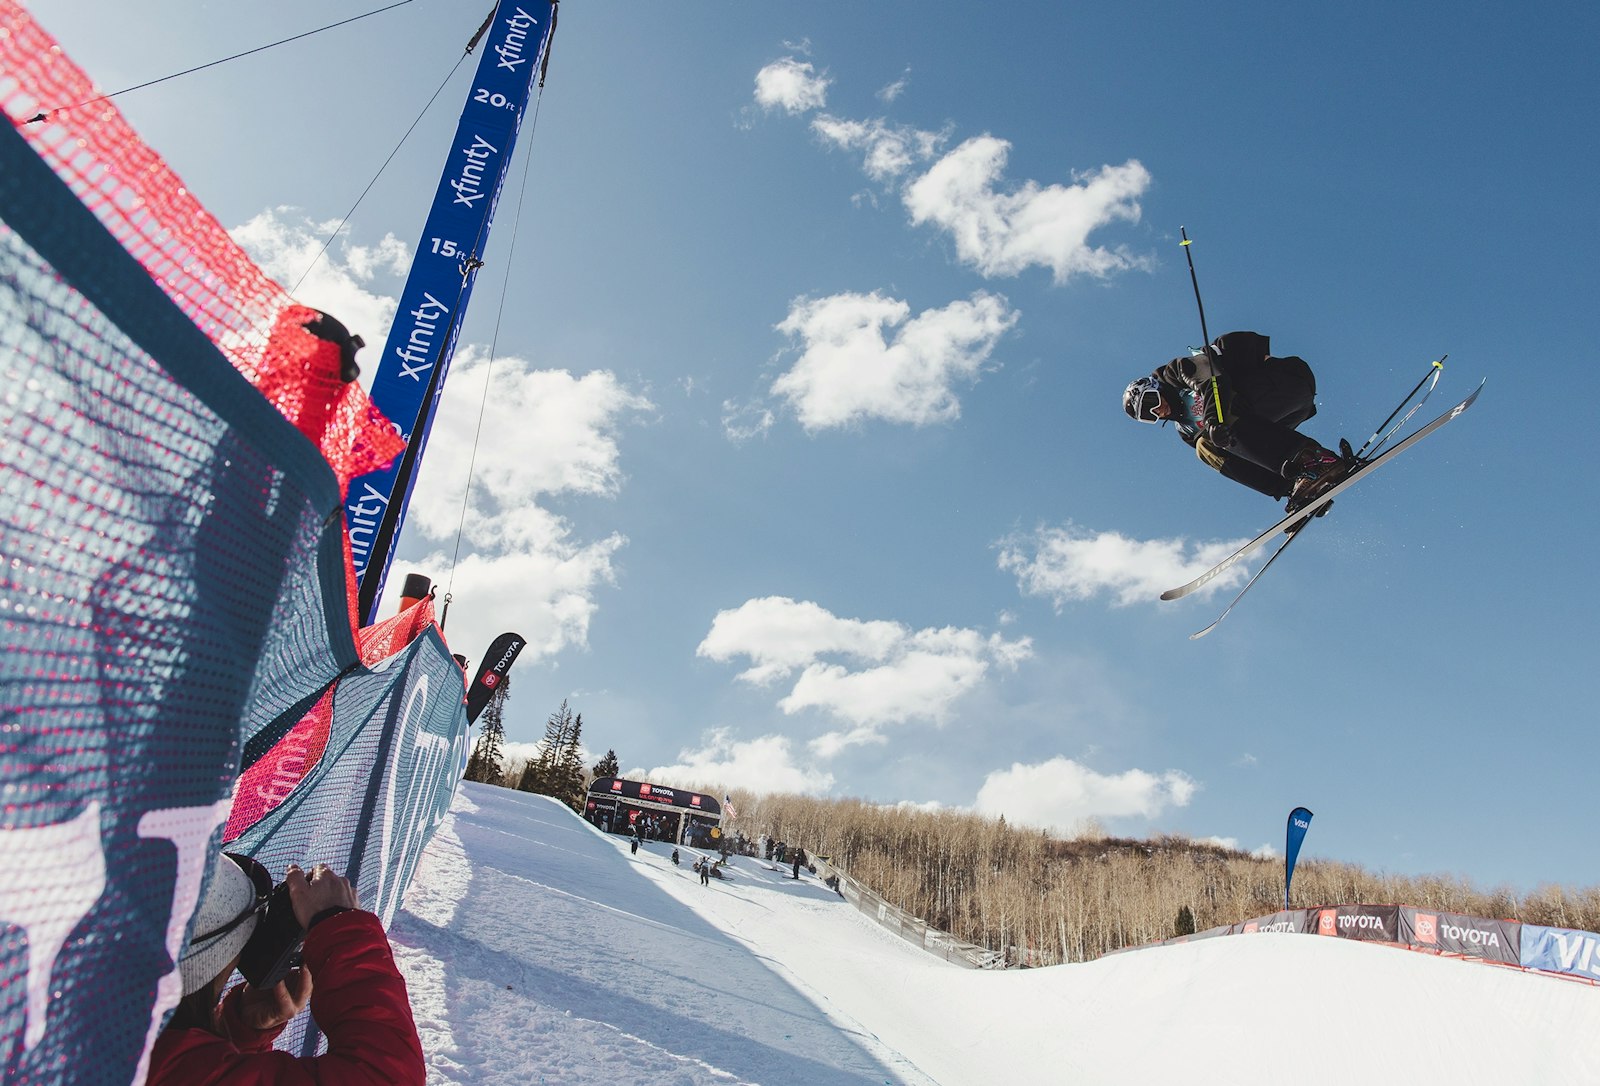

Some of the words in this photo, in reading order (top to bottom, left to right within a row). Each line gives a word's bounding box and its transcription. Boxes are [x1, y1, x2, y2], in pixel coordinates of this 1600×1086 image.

[495, 6, 537, 72] xfinity
[450, 134, 498, 208] xfinity
[396, 292, 449, 382] xfinity
[348, 482, 389, 574] inity
[493, 641, 519, 672] TOYOTA
[652, 787, 674, 797] TOYOTA
[1294, 817, 1308, 829] VISA
[1338, 915, 1384, 930] TOYOTA
[1441, 925, 1500, 948] TOYOTA
